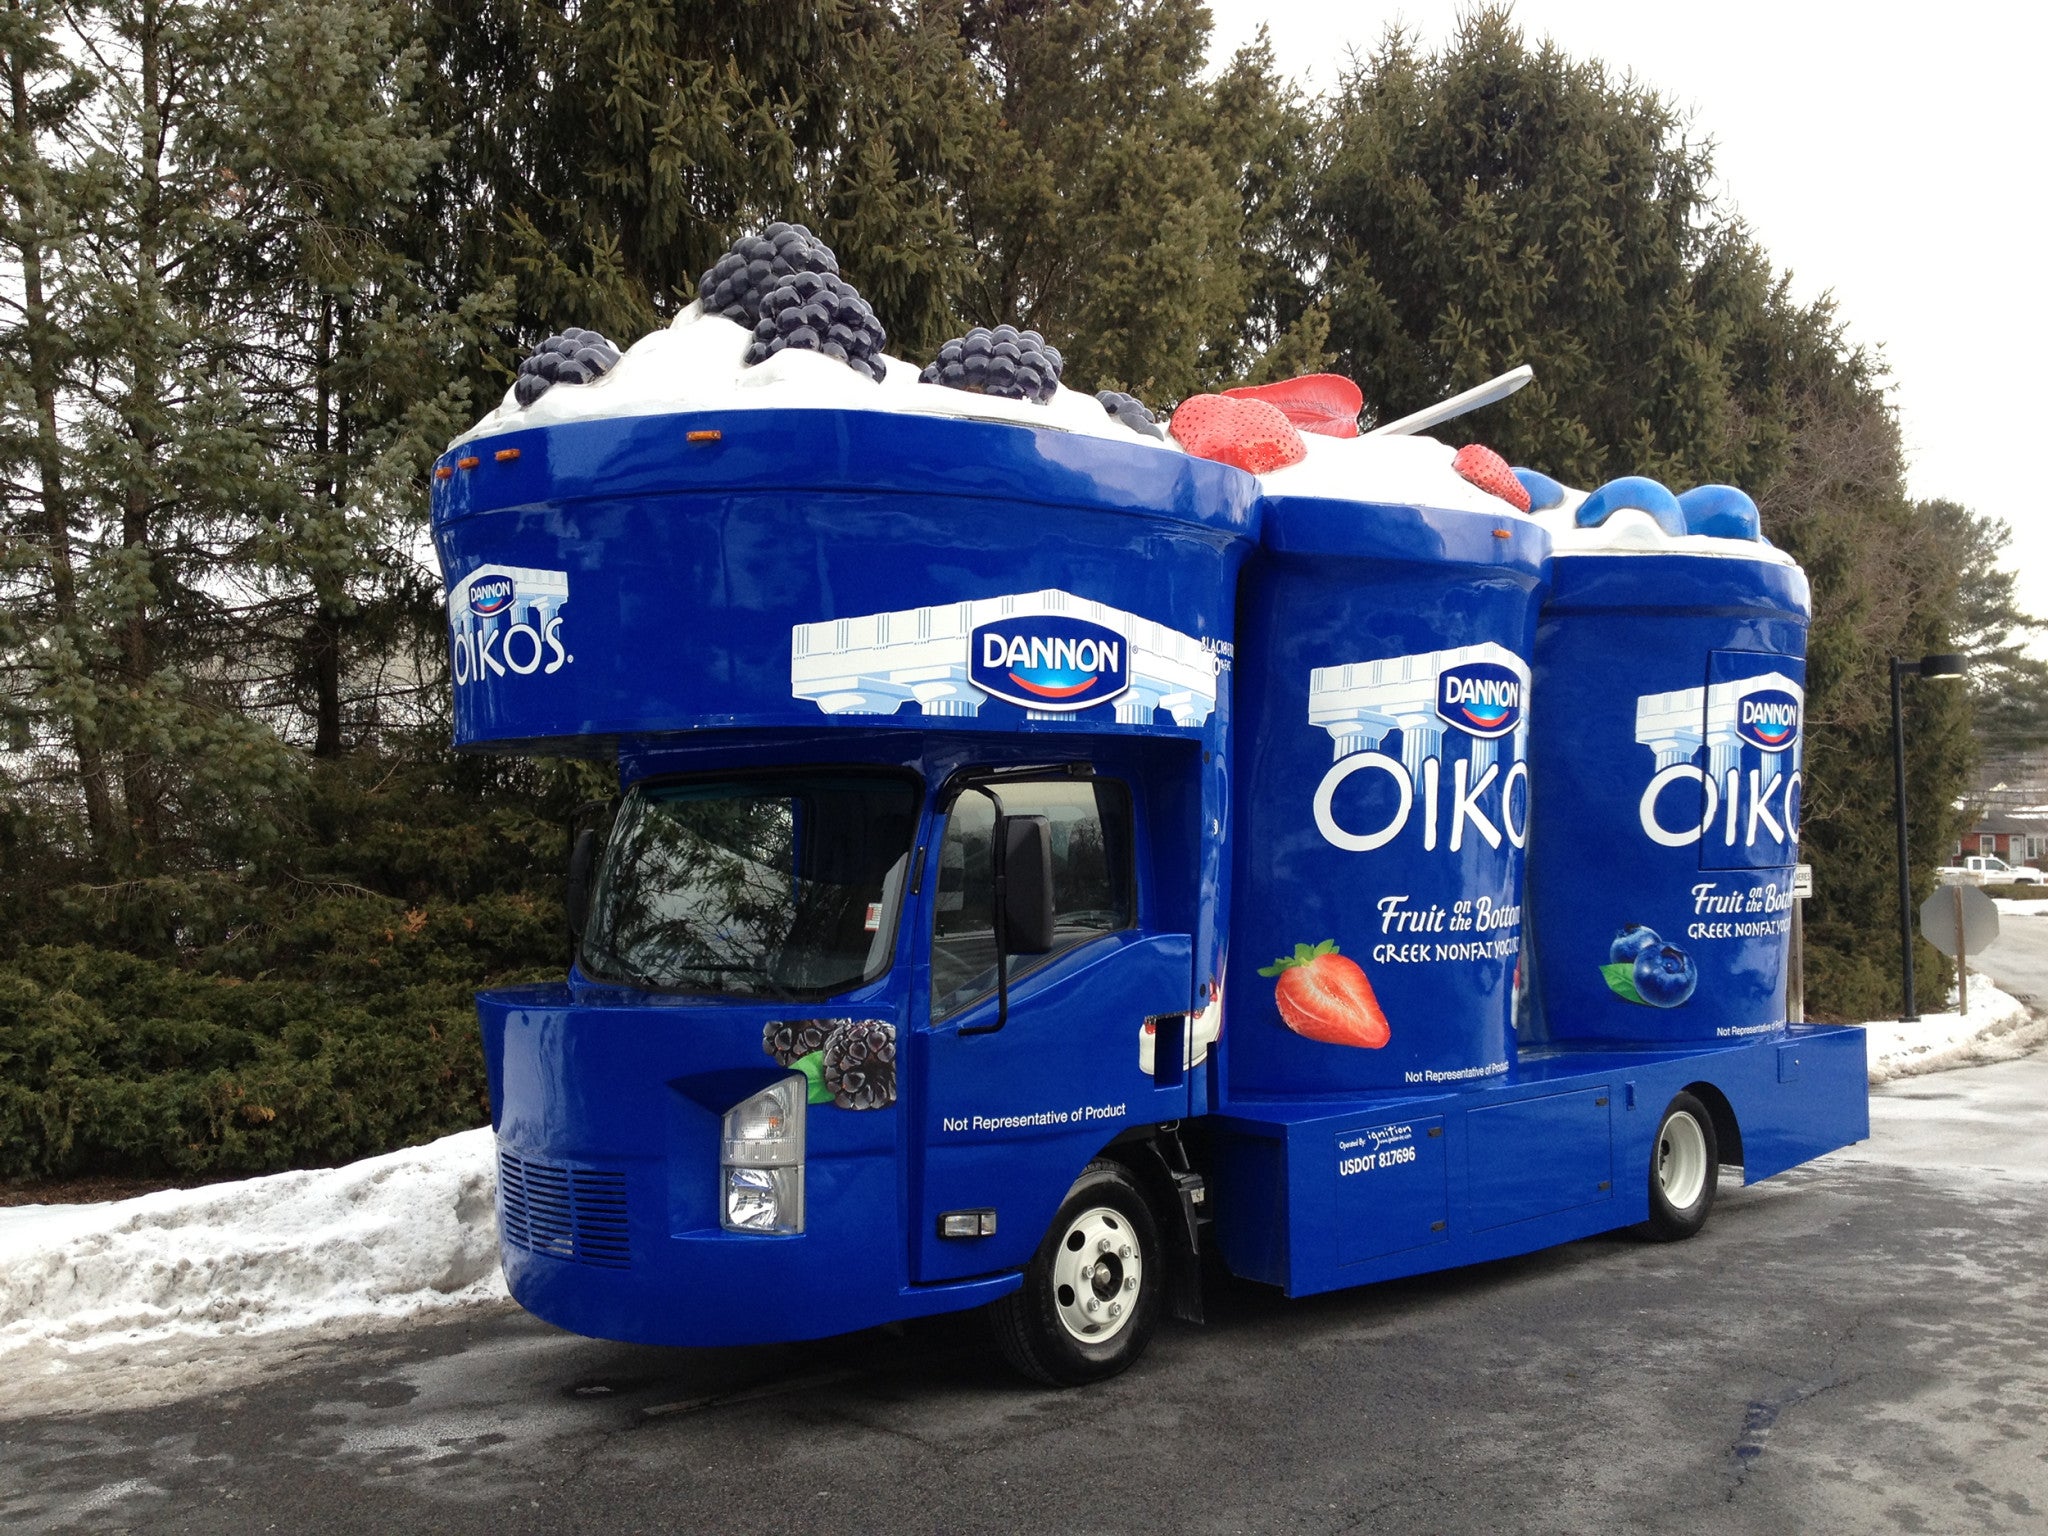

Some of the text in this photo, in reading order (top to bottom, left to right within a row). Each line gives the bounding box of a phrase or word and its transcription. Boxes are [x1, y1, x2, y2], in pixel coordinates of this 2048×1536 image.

[470, 581, 511, 602] DANNON
[983, 633, 1118, 673] DANNON
[1445, 676, 1519, 708] DANNON
[1743, 701, 1797, 726] DANNON
[1691, 883, 1744, 915] Fruit
[1749, 887, 1762, 898] on
[1377, 895, 1446, 934] Fruit
[1453, 900, 1471, 914] on
[1745, 898, 1762, 913] the
[1450, 914, 1472, 931] the
[1688, 922, 1732, 939] GREEK
[1735, 920, 1776, 937] NONFAT
[1373, 944, 1431, 964] GREEK
[1435, 941, 1492, 962] NONFAT
[1716, 1027, 1730, 1036] Not
[1405, 1071, 1423, 1082] Not
[1425, 1066, 1484, 1083] Representative
[1484, 1065, 1492, 1075] of
[943, 1102, 1126, 1131] Not Representative of Product
[1366, 1125, 1412, 1151] ignition
[1340, 1146, 1416, 1176] USDOT 817696
